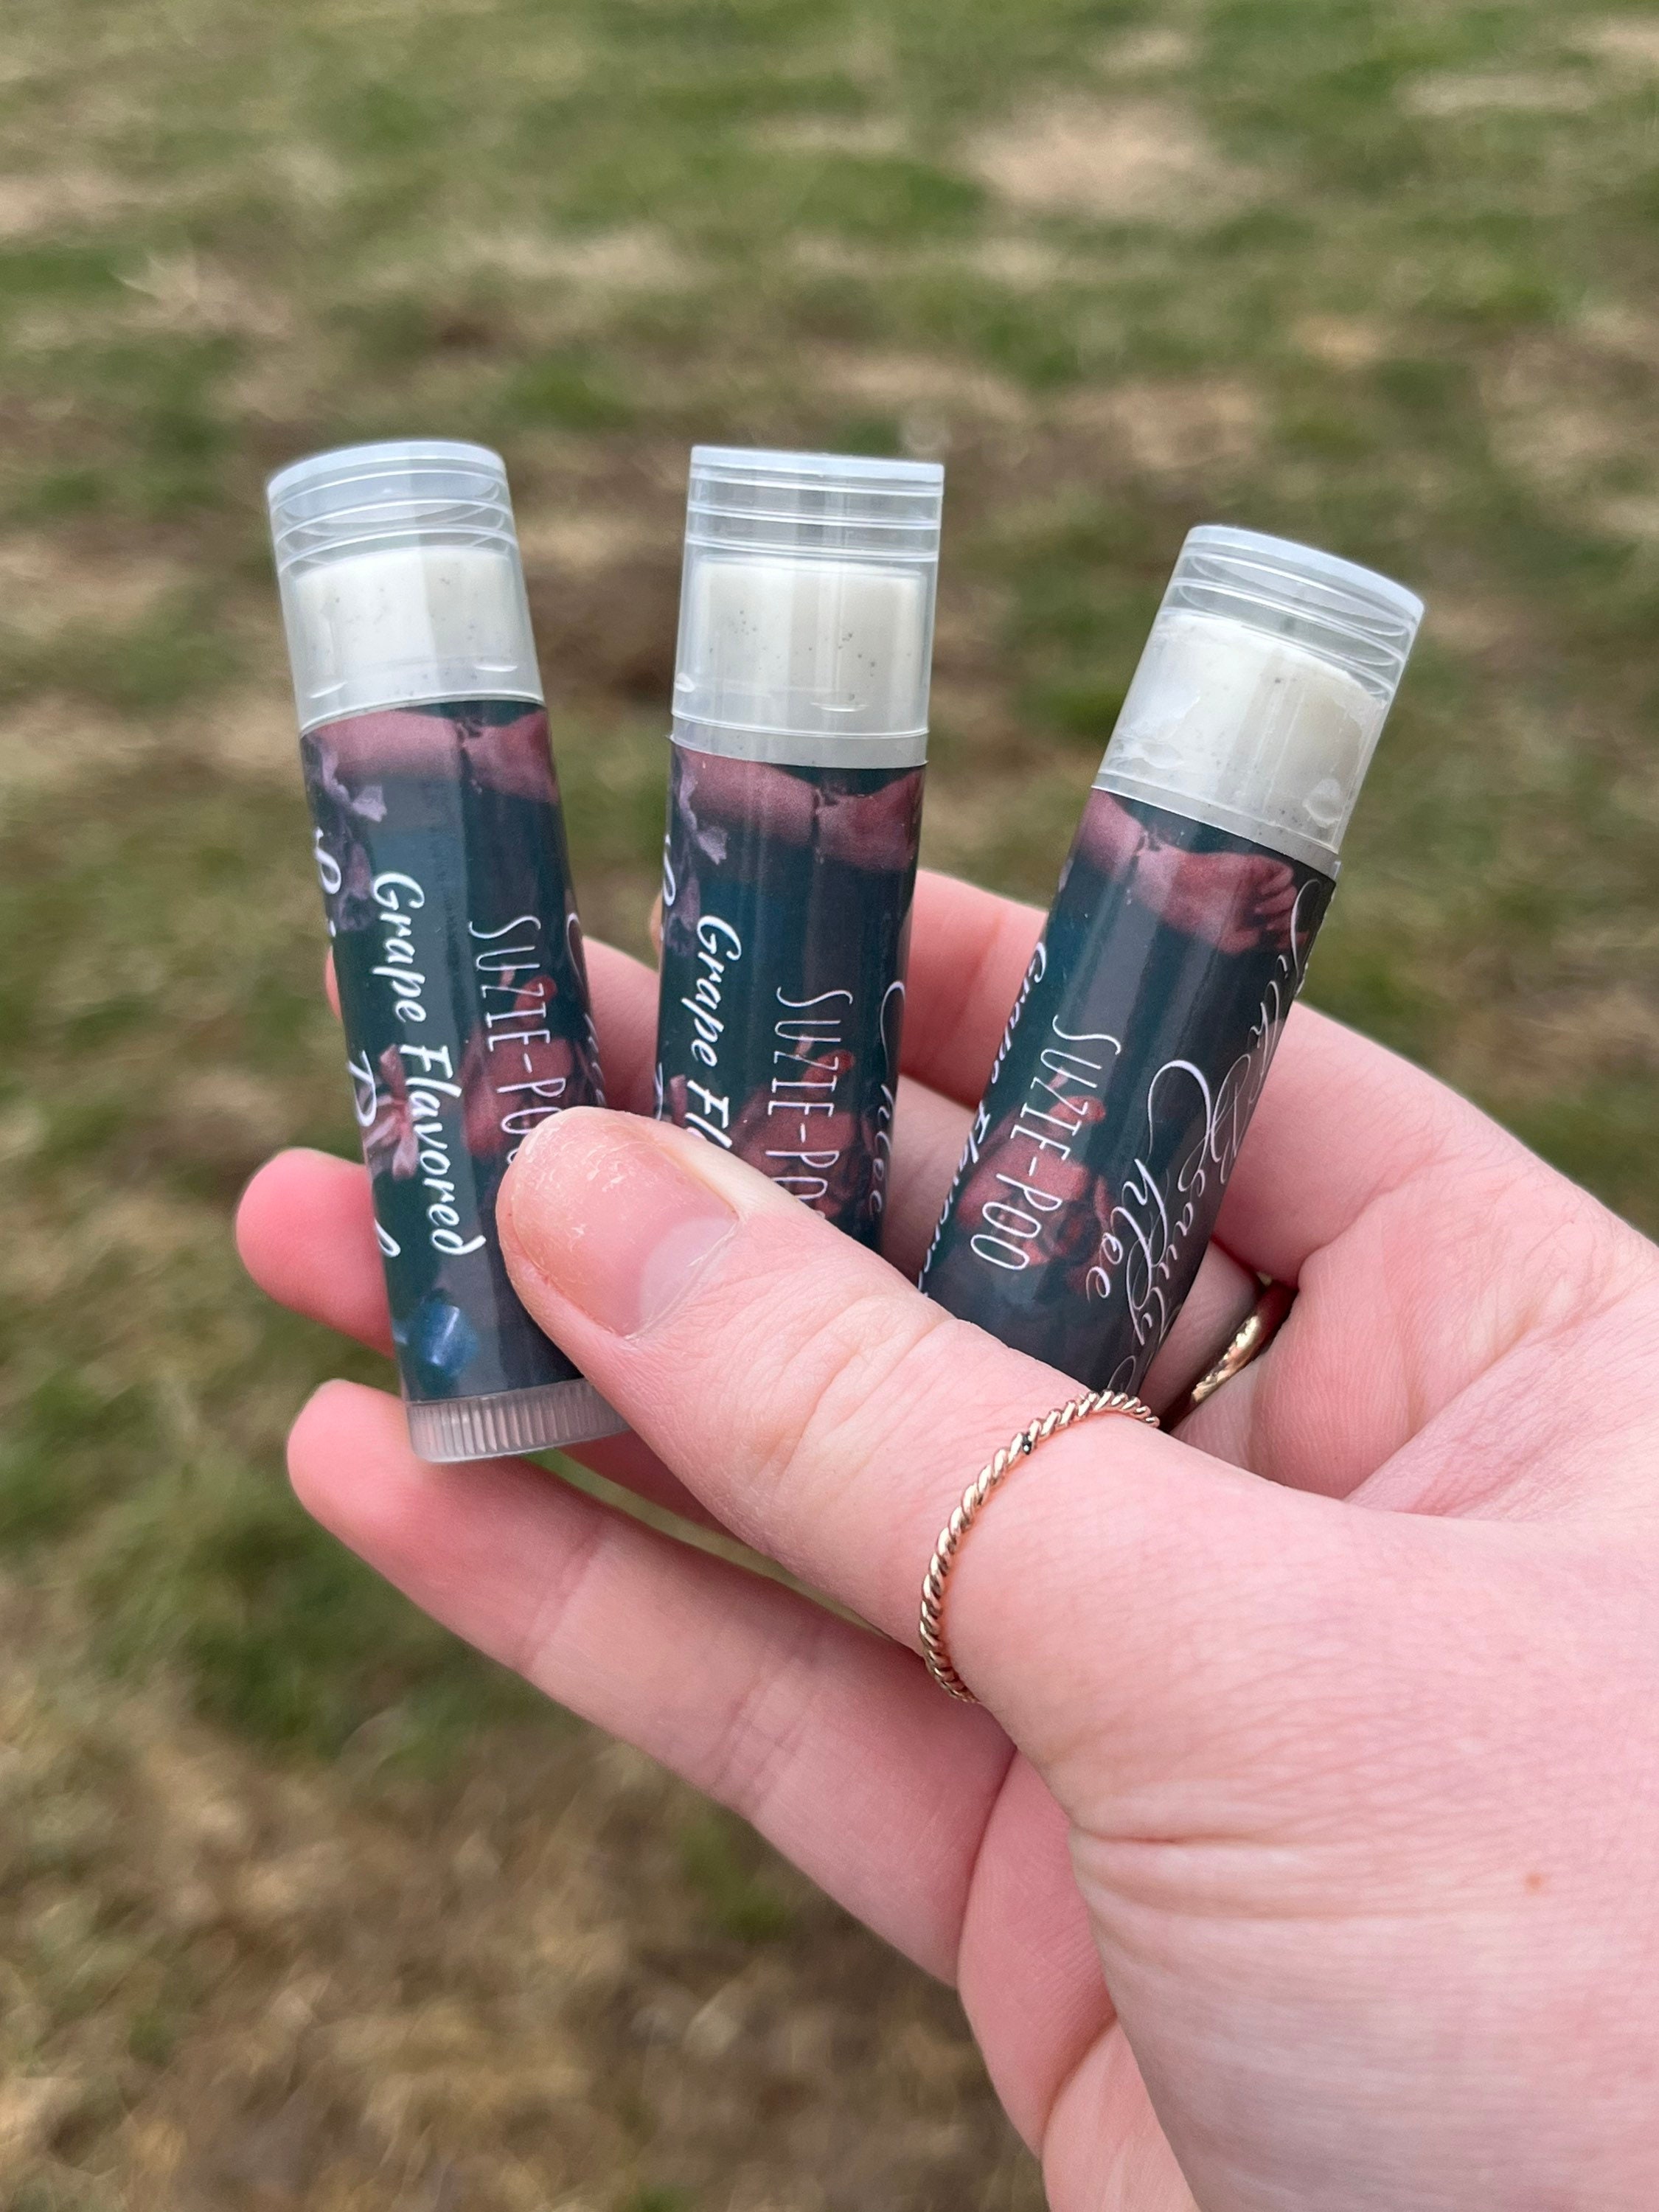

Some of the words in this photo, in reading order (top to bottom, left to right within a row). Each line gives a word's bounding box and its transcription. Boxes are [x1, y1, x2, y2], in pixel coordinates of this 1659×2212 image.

[371, 872, 427, 1023] Grape
[399, 1044, 487, 1255] Flavored
[468, 915, 567, 1165] SUZIE-PO
[681, 914, 742, 1068] Grape
[765, 986, 853, 1218] SUZIE-PO
[970, 1014, 1121, 1271] SUZIE-POO
[1086, 1059, 1213, 1310] Chloe
